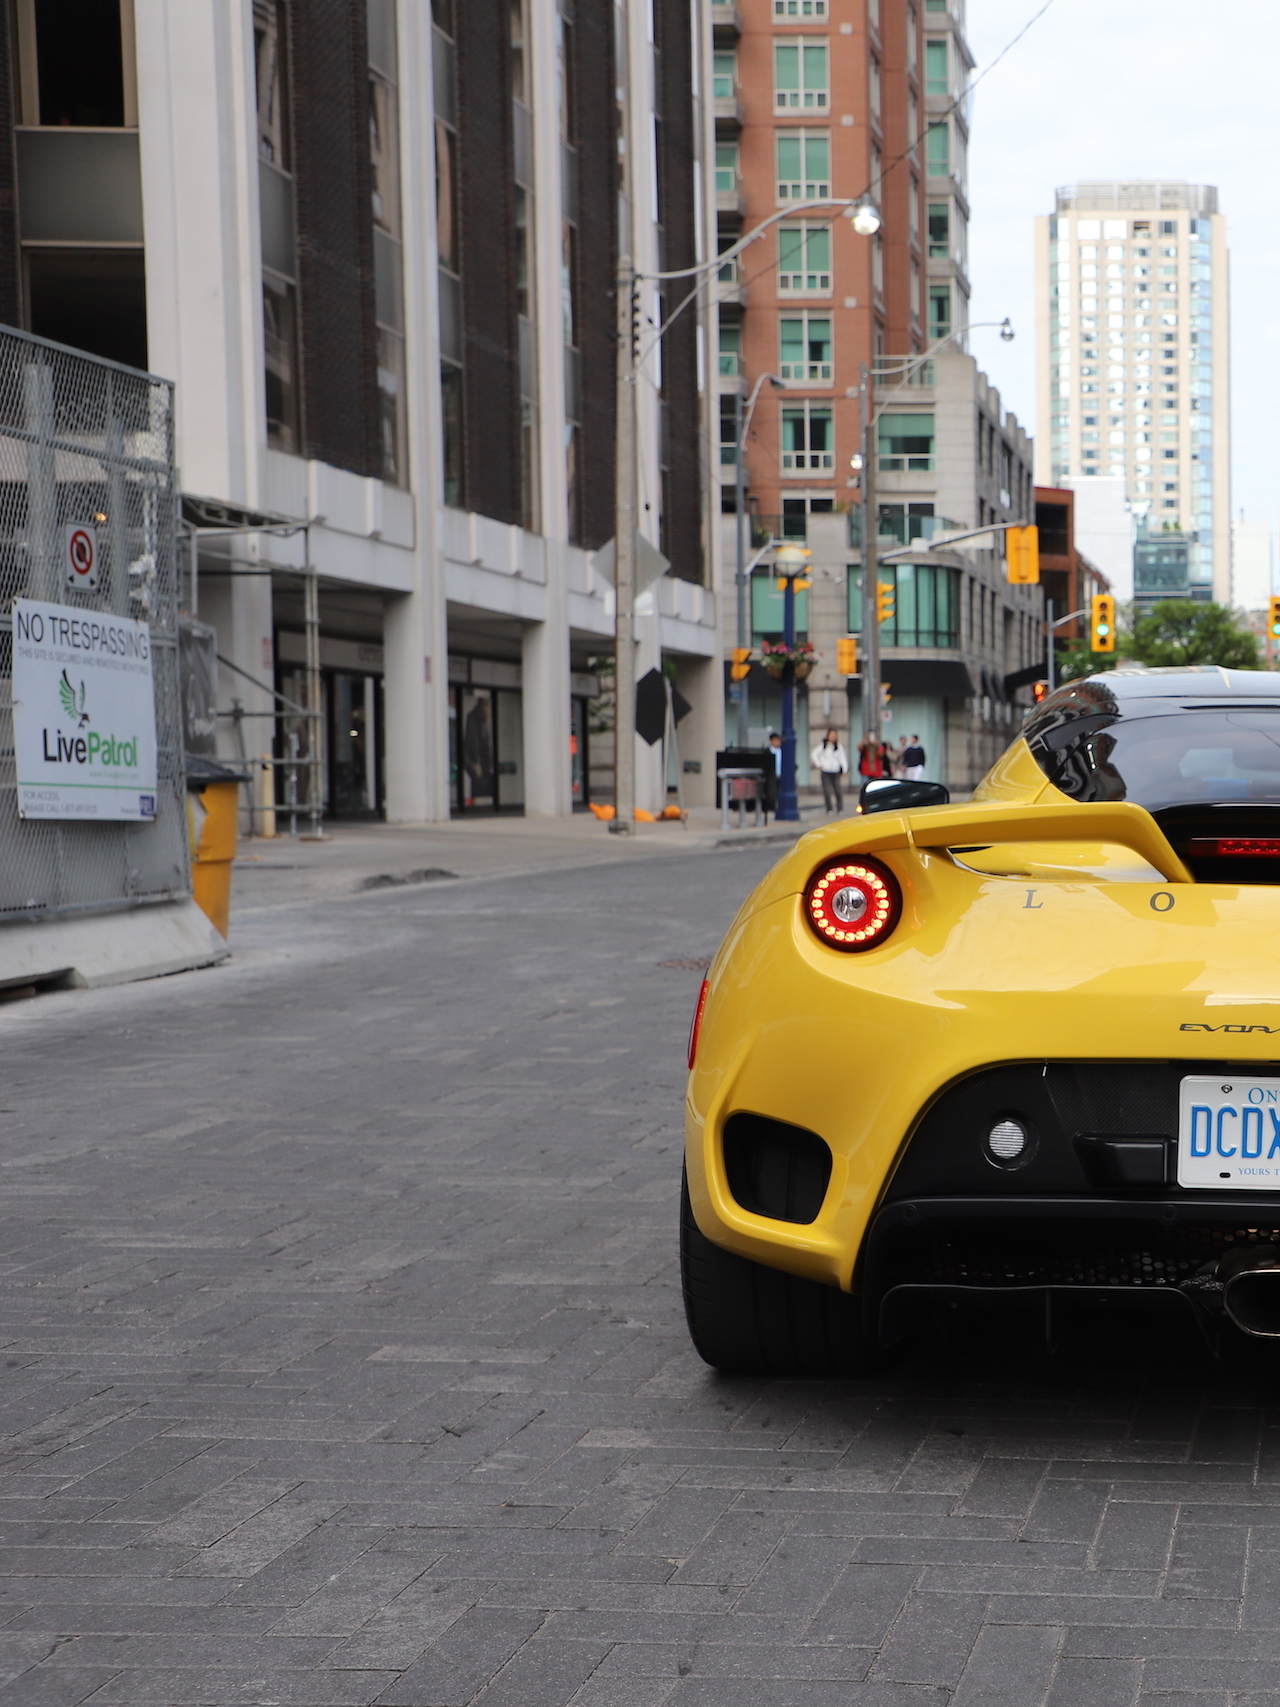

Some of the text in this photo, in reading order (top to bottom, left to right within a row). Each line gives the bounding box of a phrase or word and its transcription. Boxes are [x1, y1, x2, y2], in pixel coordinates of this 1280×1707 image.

[17, 611, 149, 660] NO TRESPASSING
[43, 728, 138, 768] LivePatrol
[1238, 1167, 1271, 1176] YOURS
